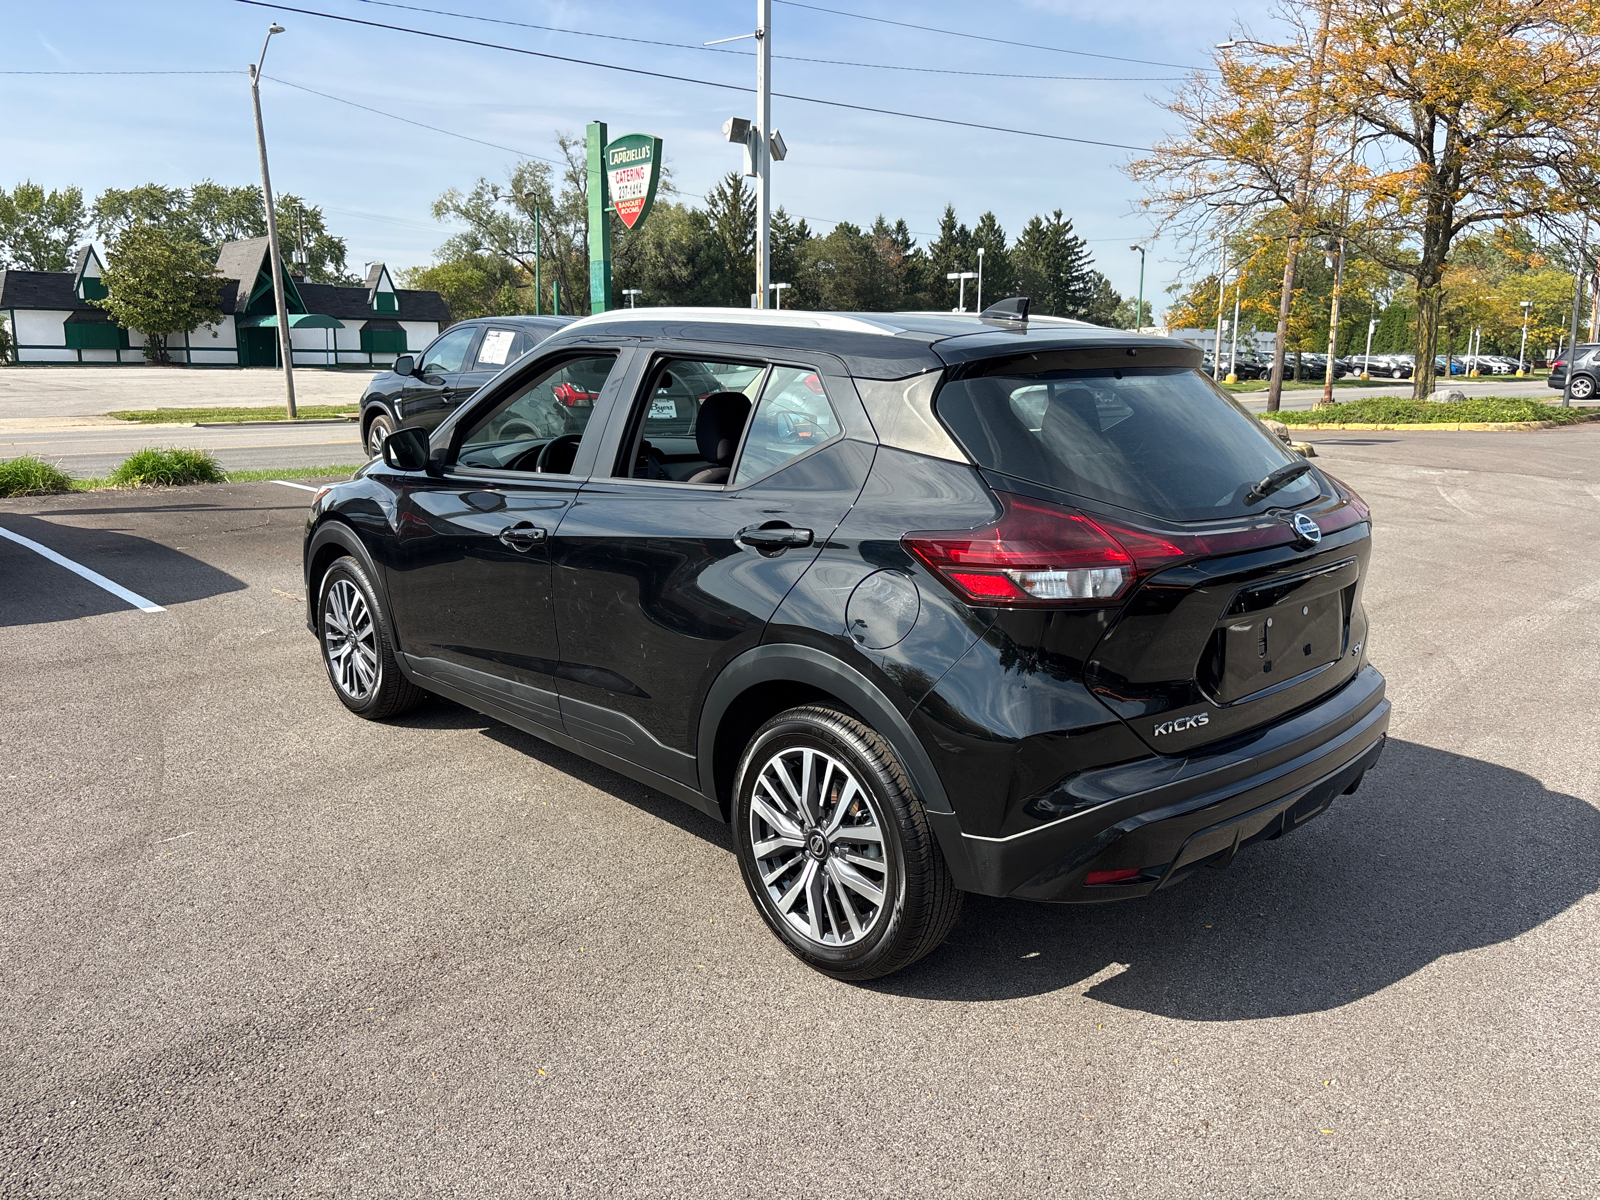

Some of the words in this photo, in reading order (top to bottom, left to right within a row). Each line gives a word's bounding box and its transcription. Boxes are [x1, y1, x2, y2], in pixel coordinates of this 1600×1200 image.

[615, 166, 645, 184] CATERING
[618, 183, 642, 199] 237-1414
[618, 198, 642, 209] BANQUET
[621, 206, 640, 215] ROOMS
[1153, 711, 1210, 737] KICKS
